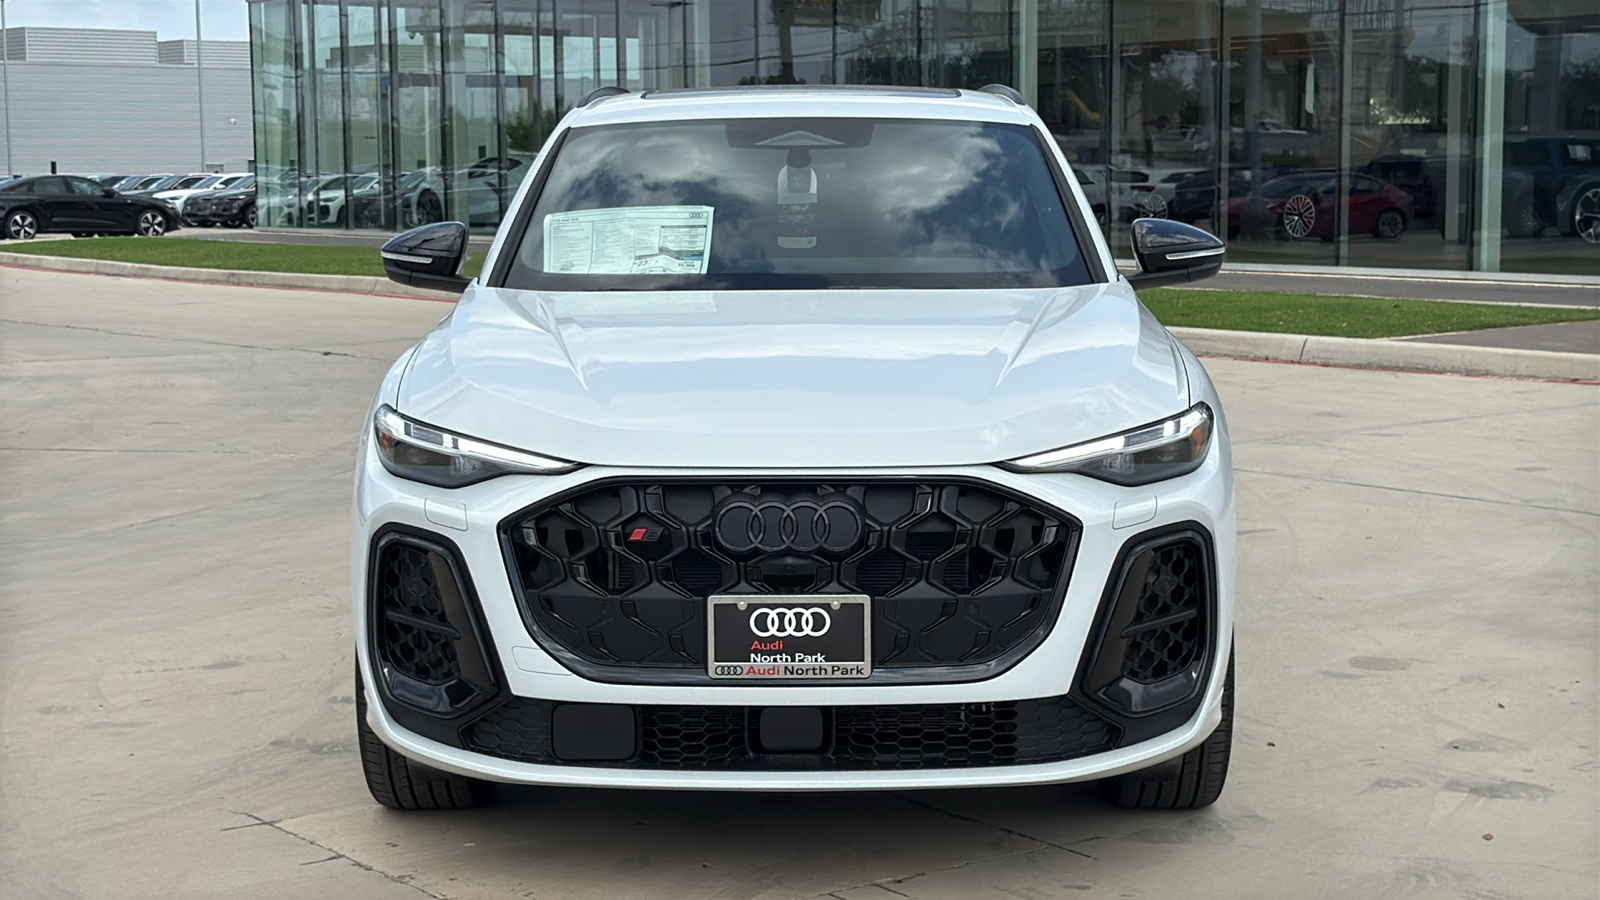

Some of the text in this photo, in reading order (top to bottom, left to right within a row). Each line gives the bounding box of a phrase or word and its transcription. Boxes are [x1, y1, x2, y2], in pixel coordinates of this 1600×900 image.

[751, 640, 783, 650] Audi
[750, 653, 826, 663] North Park
[746, 665, 864, 676] Audi North Park
